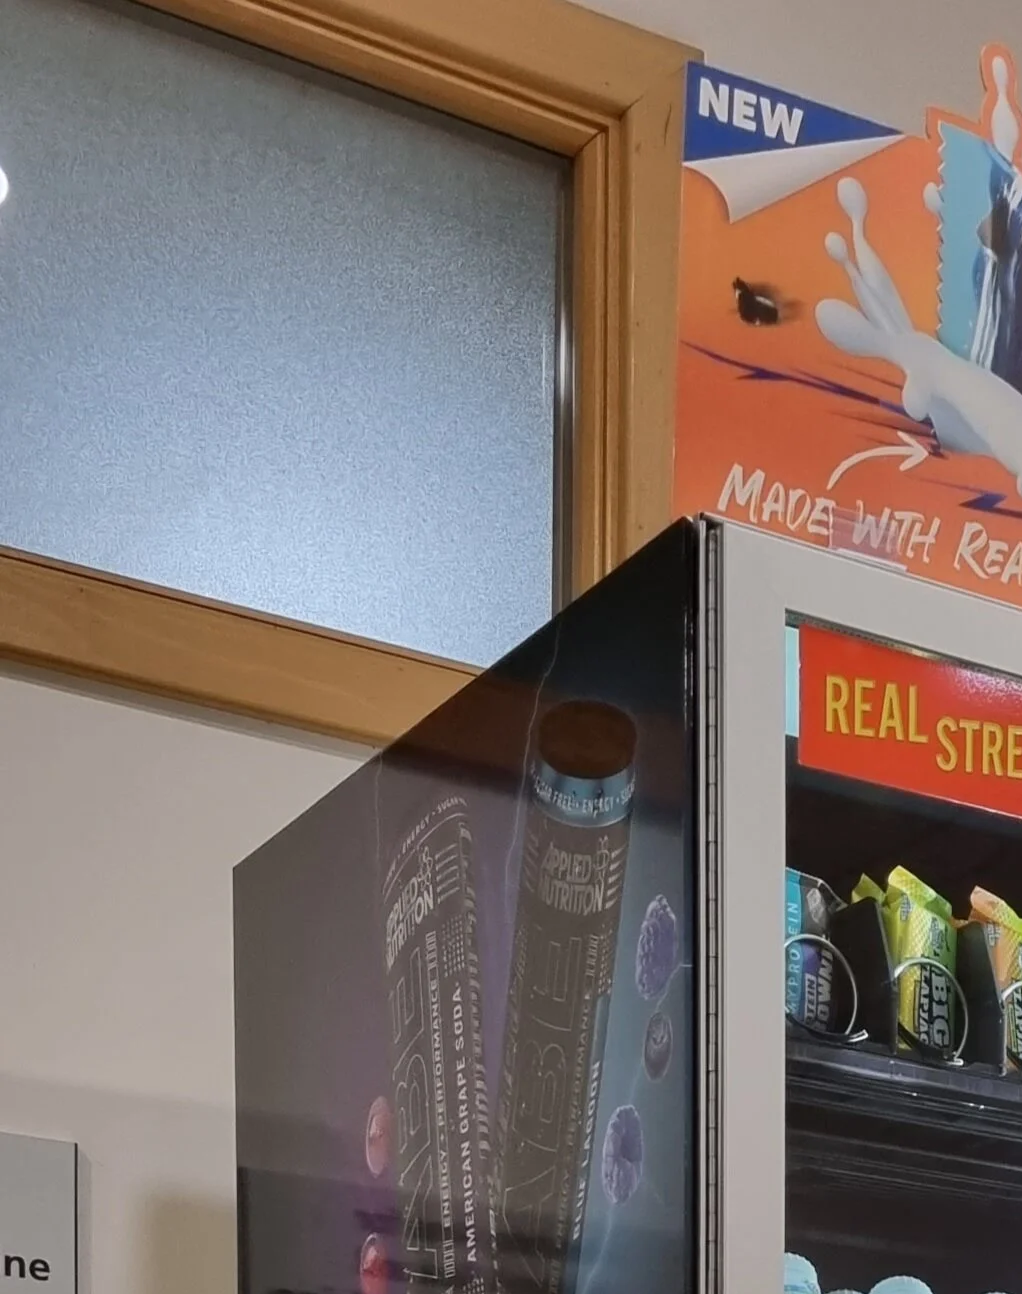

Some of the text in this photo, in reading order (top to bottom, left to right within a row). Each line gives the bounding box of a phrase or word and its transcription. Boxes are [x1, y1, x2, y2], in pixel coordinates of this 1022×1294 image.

[698, 78, 803, 145] NEW
[717, 463, 833, 535] MADE
[852, 503, 940, 565] WITH
[824, 675, 929, 745] REAL
[541, 876, 604, 915] NUTRITION
[787, 902, 800, 1014] MYPROEIN
[930, 973, 950, 1047] BIG
[429, 978, 446, 1127] PERFORMANCE
[456, 1056, 471, 1134] GRAPE
[572, 1060, 601, 1241] BLUE LAGOON
[459, 1141, 478, 1263] AMERICAN
[4, 1254, 50, 1281] ne
